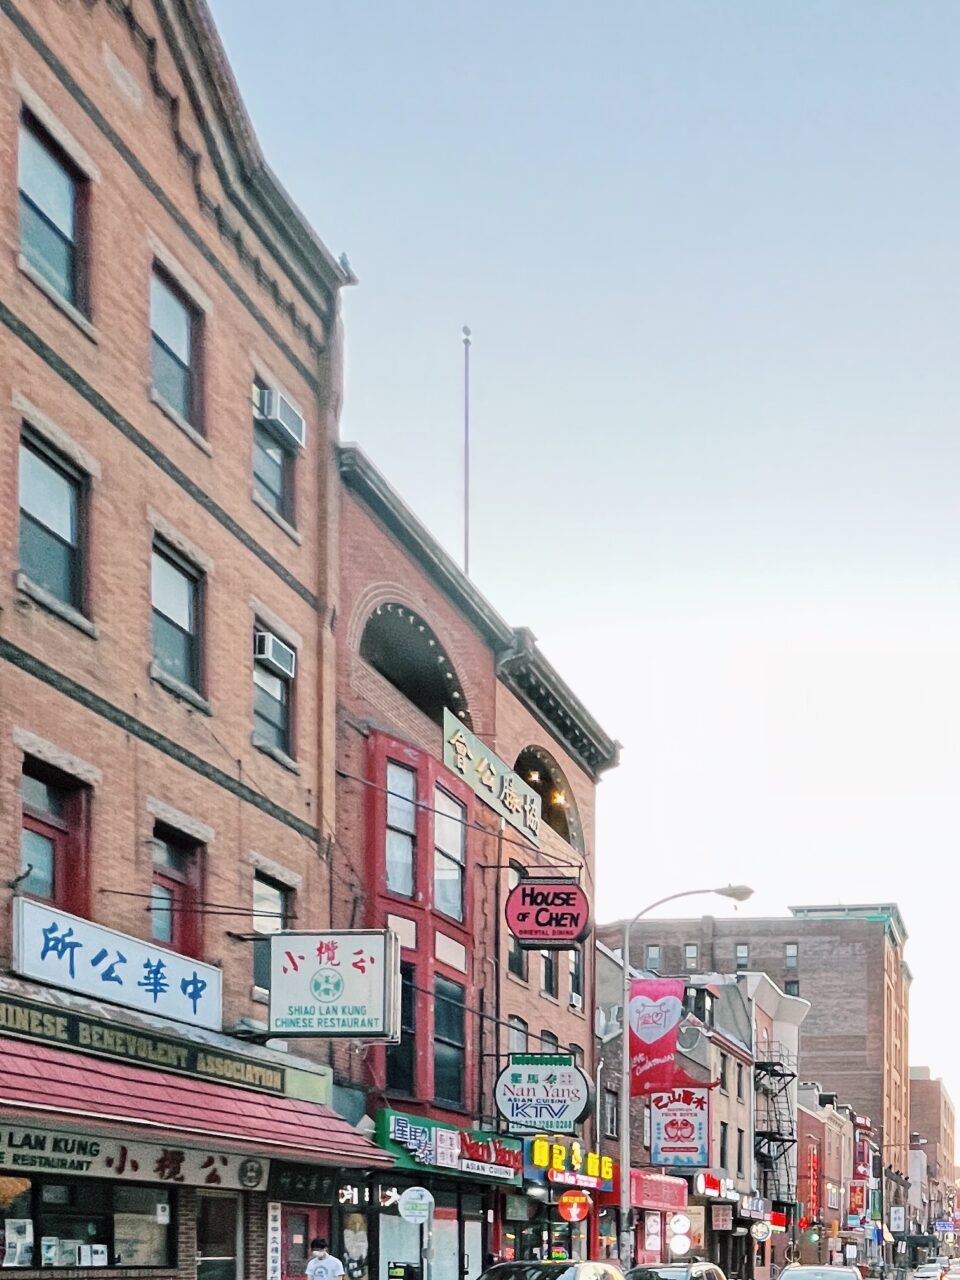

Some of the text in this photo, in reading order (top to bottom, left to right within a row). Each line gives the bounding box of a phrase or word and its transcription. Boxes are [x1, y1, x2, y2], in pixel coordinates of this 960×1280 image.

[516, 912, 531, 922] OF
[288, 1005, 367, 1016] SHIAO LAN KUNG
[274, 1018, 380, 1028] CHINESE RESTAURANT
[78, 1021, 189, 1068] BENEVOLENT
[196, 1052, 281, 1090] ASSOCIATION
[502, 1084, 581, 1102] Nan Yang
[511, 1102, 569, 1118] KTV
[8, 1131, 46, 1151] LAN
[52, 1137, 100, 1157] KUNG
[12, 1153, 93, 1171] RESTAURANT
[466, 1162, 486, 1172] ASIAN
